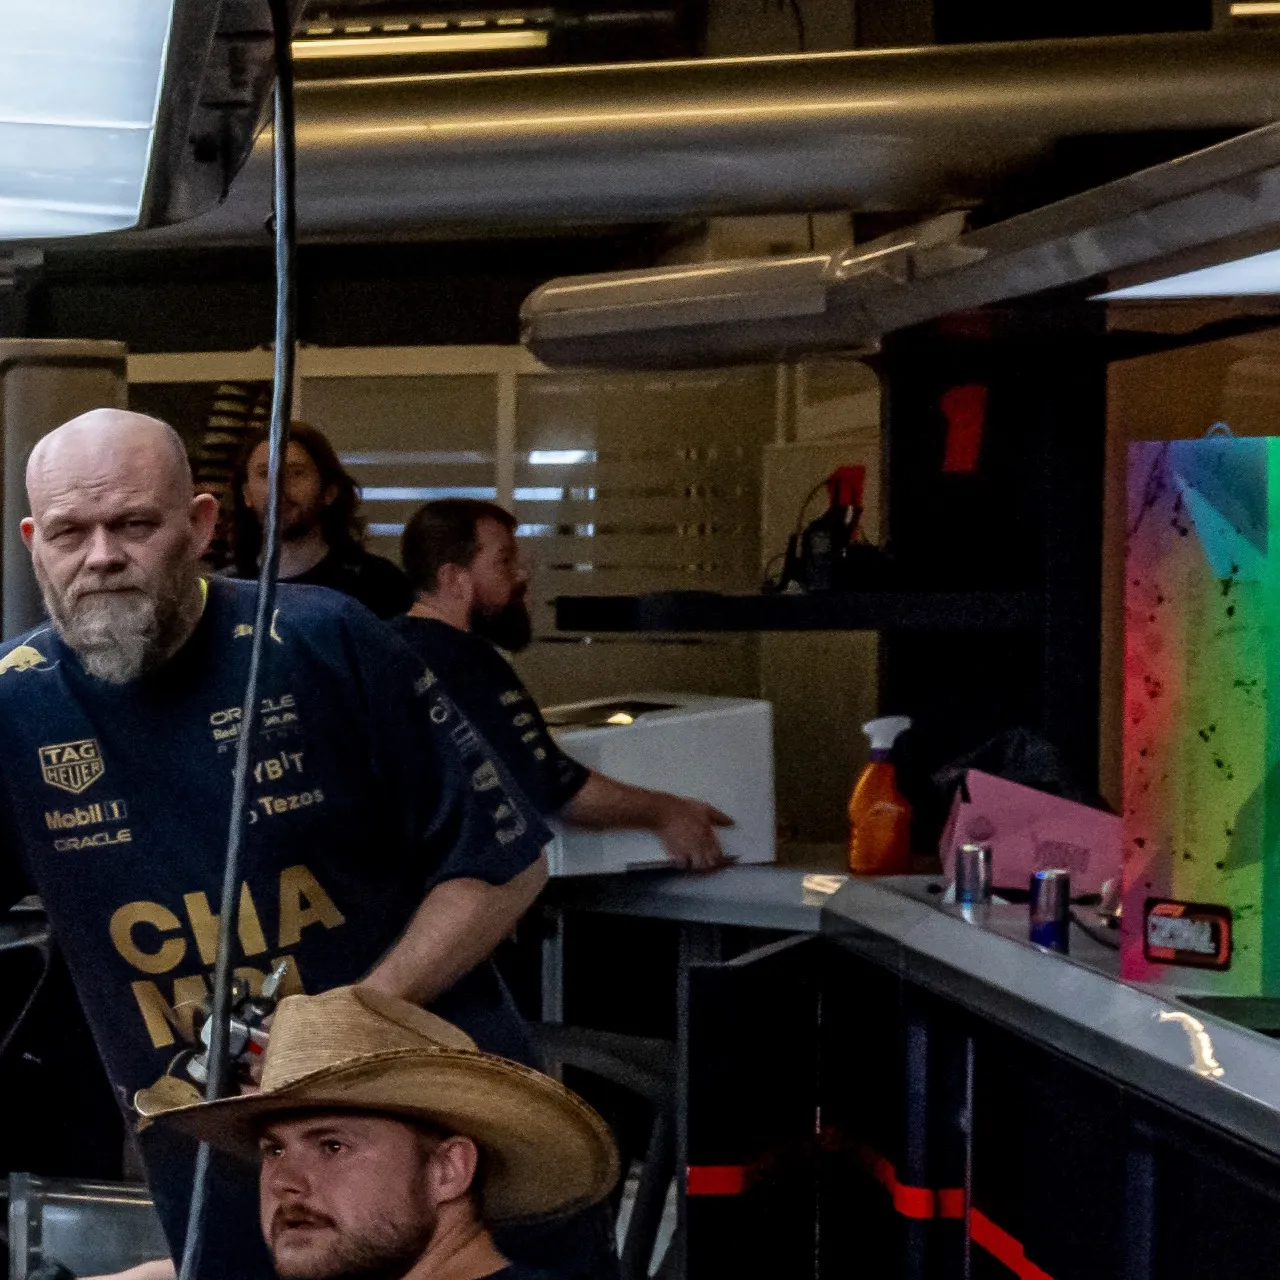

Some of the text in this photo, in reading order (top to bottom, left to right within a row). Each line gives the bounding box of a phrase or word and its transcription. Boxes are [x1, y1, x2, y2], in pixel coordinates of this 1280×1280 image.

[46, 748, 96, 765] TAG
[252, 751, 305, 784] YBIT
[46, 759, 101, 790] HEUER
[45, 803, 103, 830] Mobil
[257, 789, 324, 817] Tezos
[54, 829, 132, 851] ORACLE
[109, 864, 347, 975] CHA
